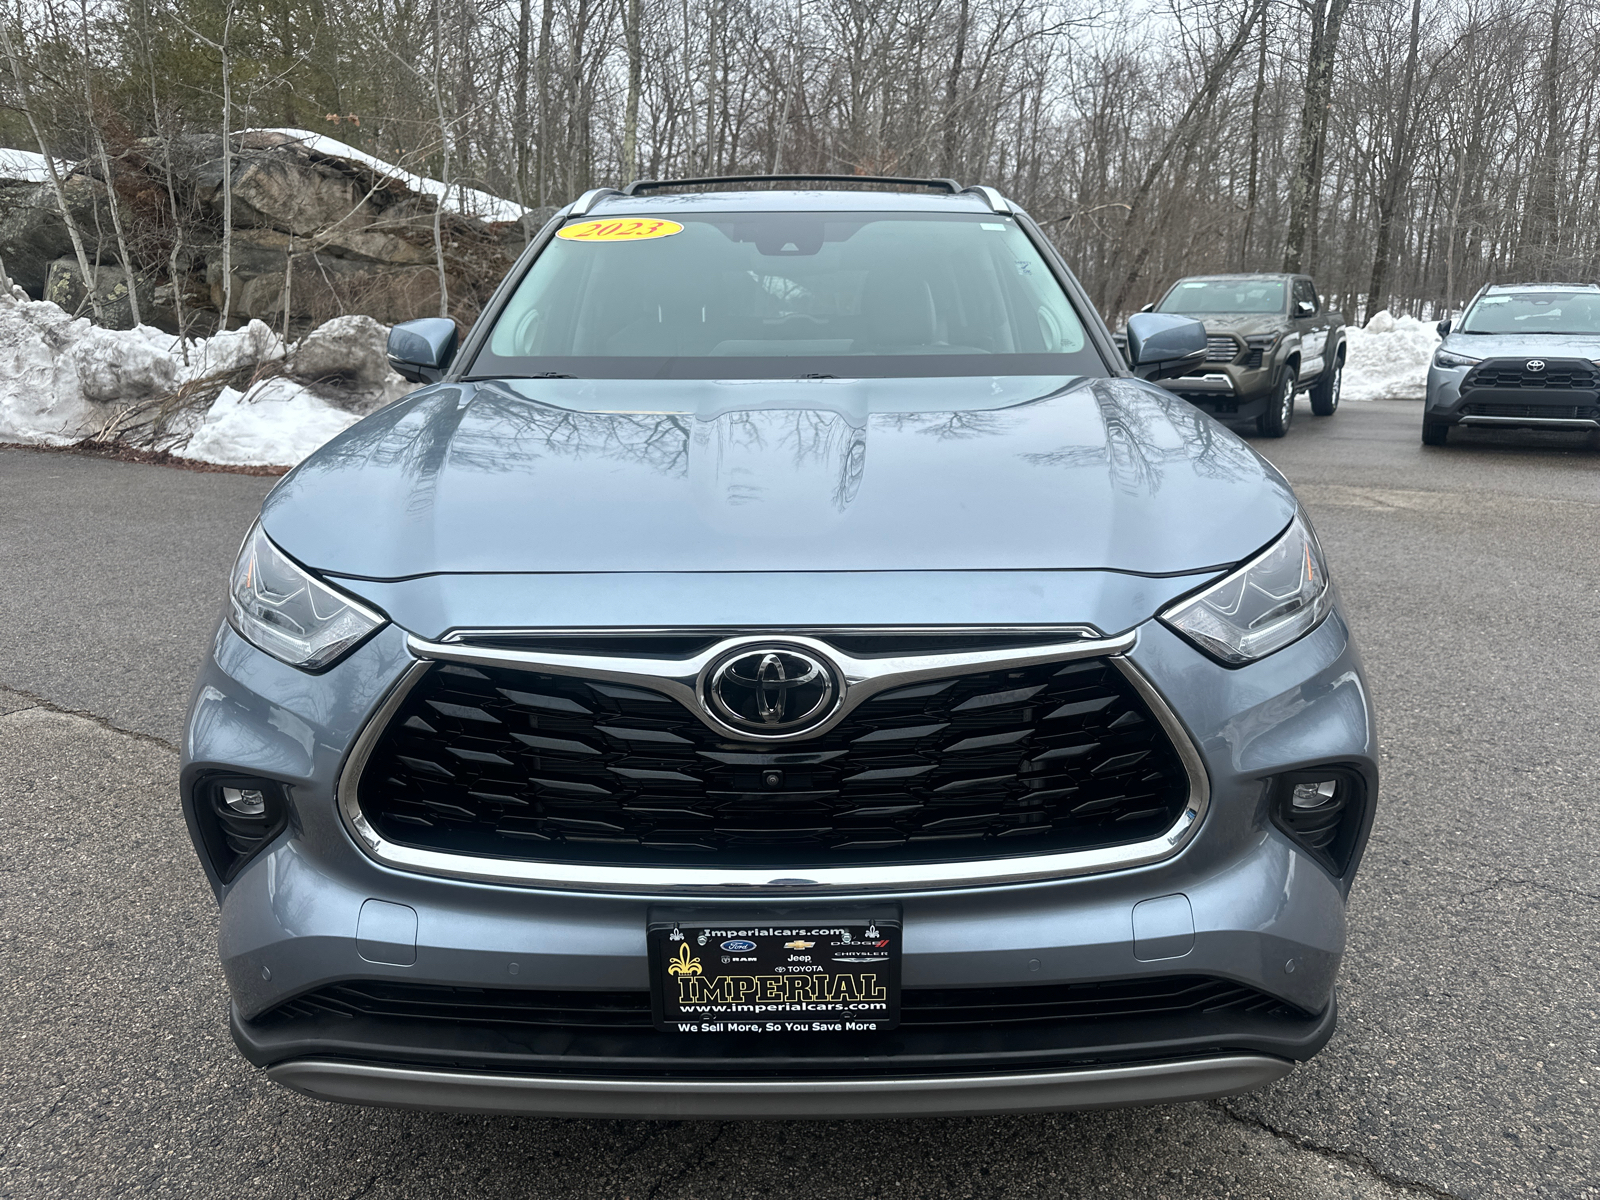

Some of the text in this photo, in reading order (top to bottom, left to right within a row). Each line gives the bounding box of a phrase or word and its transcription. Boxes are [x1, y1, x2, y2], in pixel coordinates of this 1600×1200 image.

[574, 222, 664, 237] 2023
[703, 928, 845, 938] Imperialcars.com
[787, 954, 811, 963] Jeep
[678, 974, 886, 1003] IMPERIAL
[680, 1003, 886, 1013] www.imperialcars.com
[678, 1022, 876, 1033] We Sell More, So You Save More
